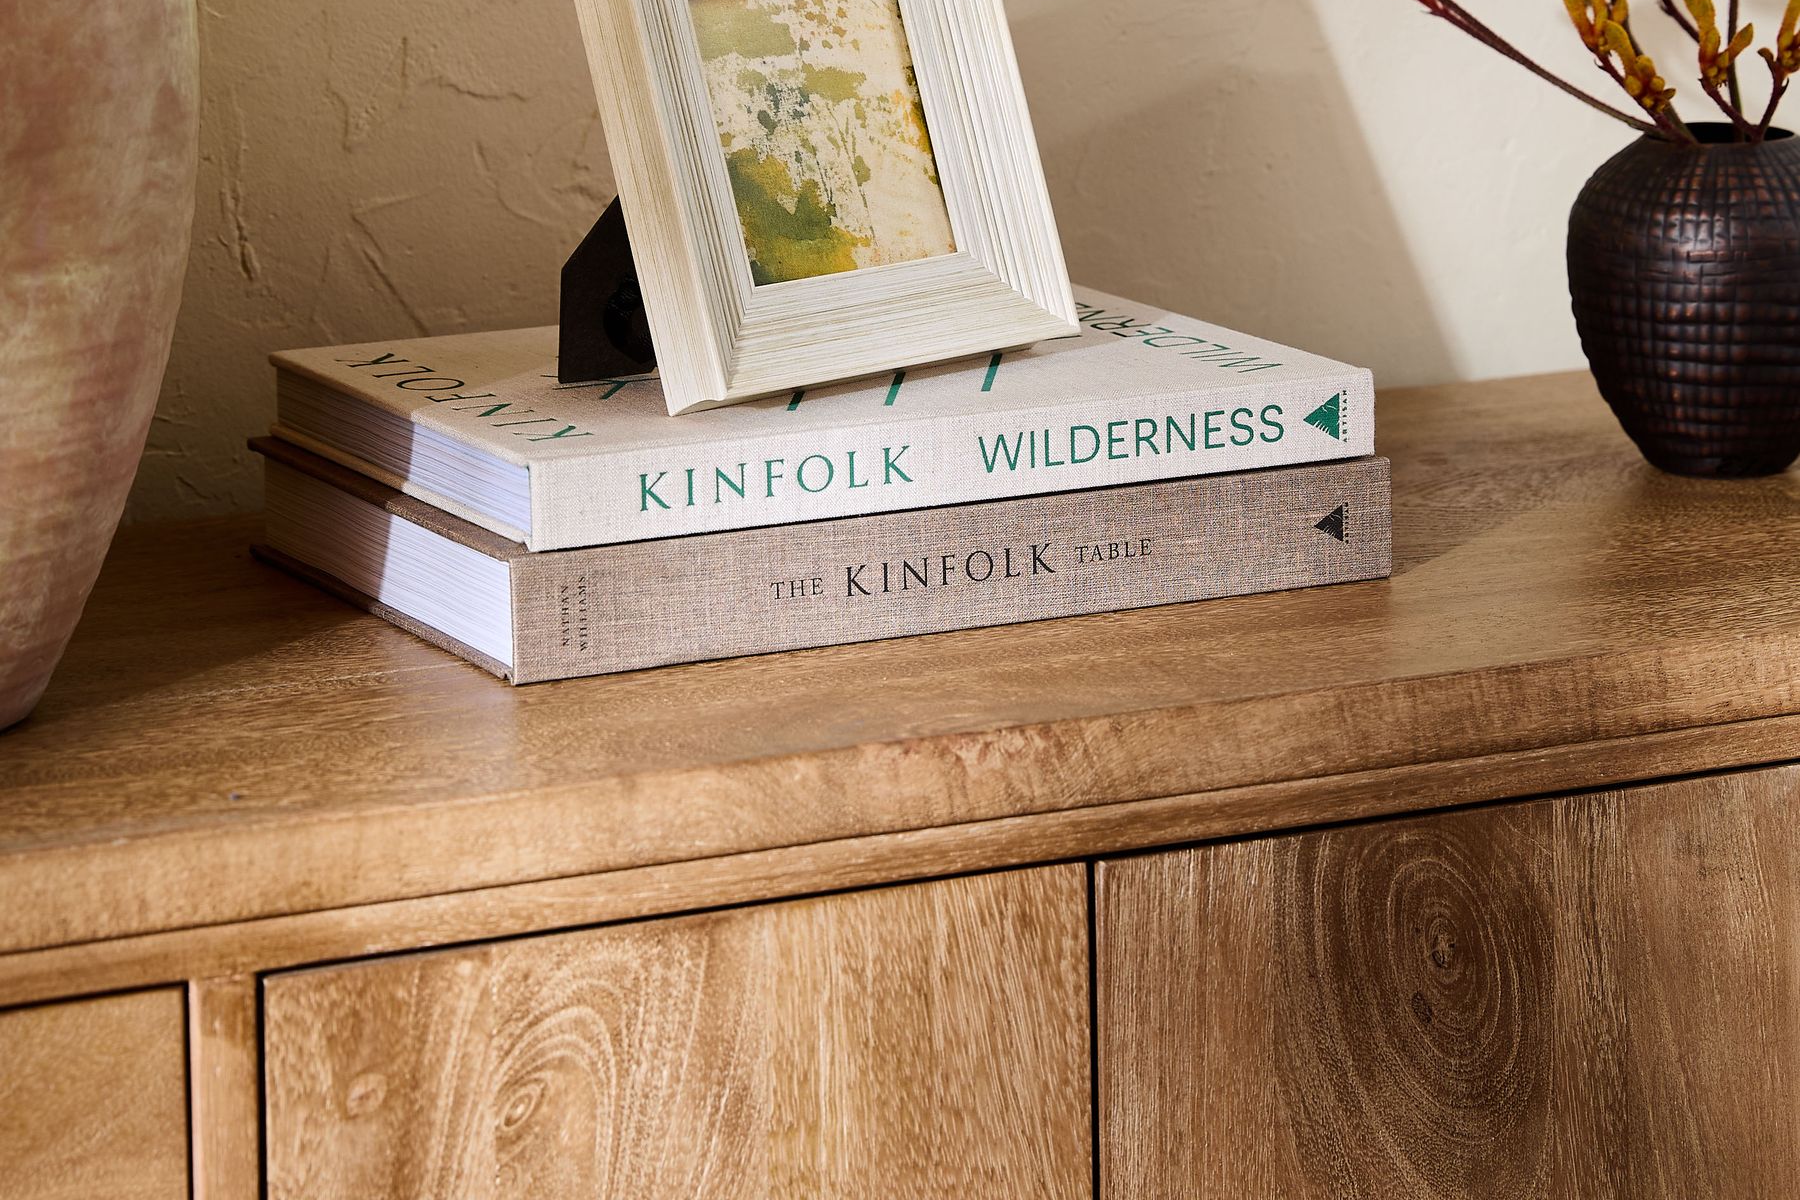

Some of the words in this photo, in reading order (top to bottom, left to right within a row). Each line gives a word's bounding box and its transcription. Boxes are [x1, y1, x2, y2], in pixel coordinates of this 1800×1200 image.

[1076, 302, 1283, 374] WILDERN
[334, 352, 594, 442] KINFOLK
[639, 445, 914, 512] KINFOLK
[978, 404, 1285, 474] WILDERNESS
[770, 577, 825, 600] THE
[845, 543, 1056, 598] KINFOLK
[1074, 538, 1153, 564] TABLE
[561, 585, 570, 647] NATHAN
[578, 576, 588, 651] WILLIAMS
